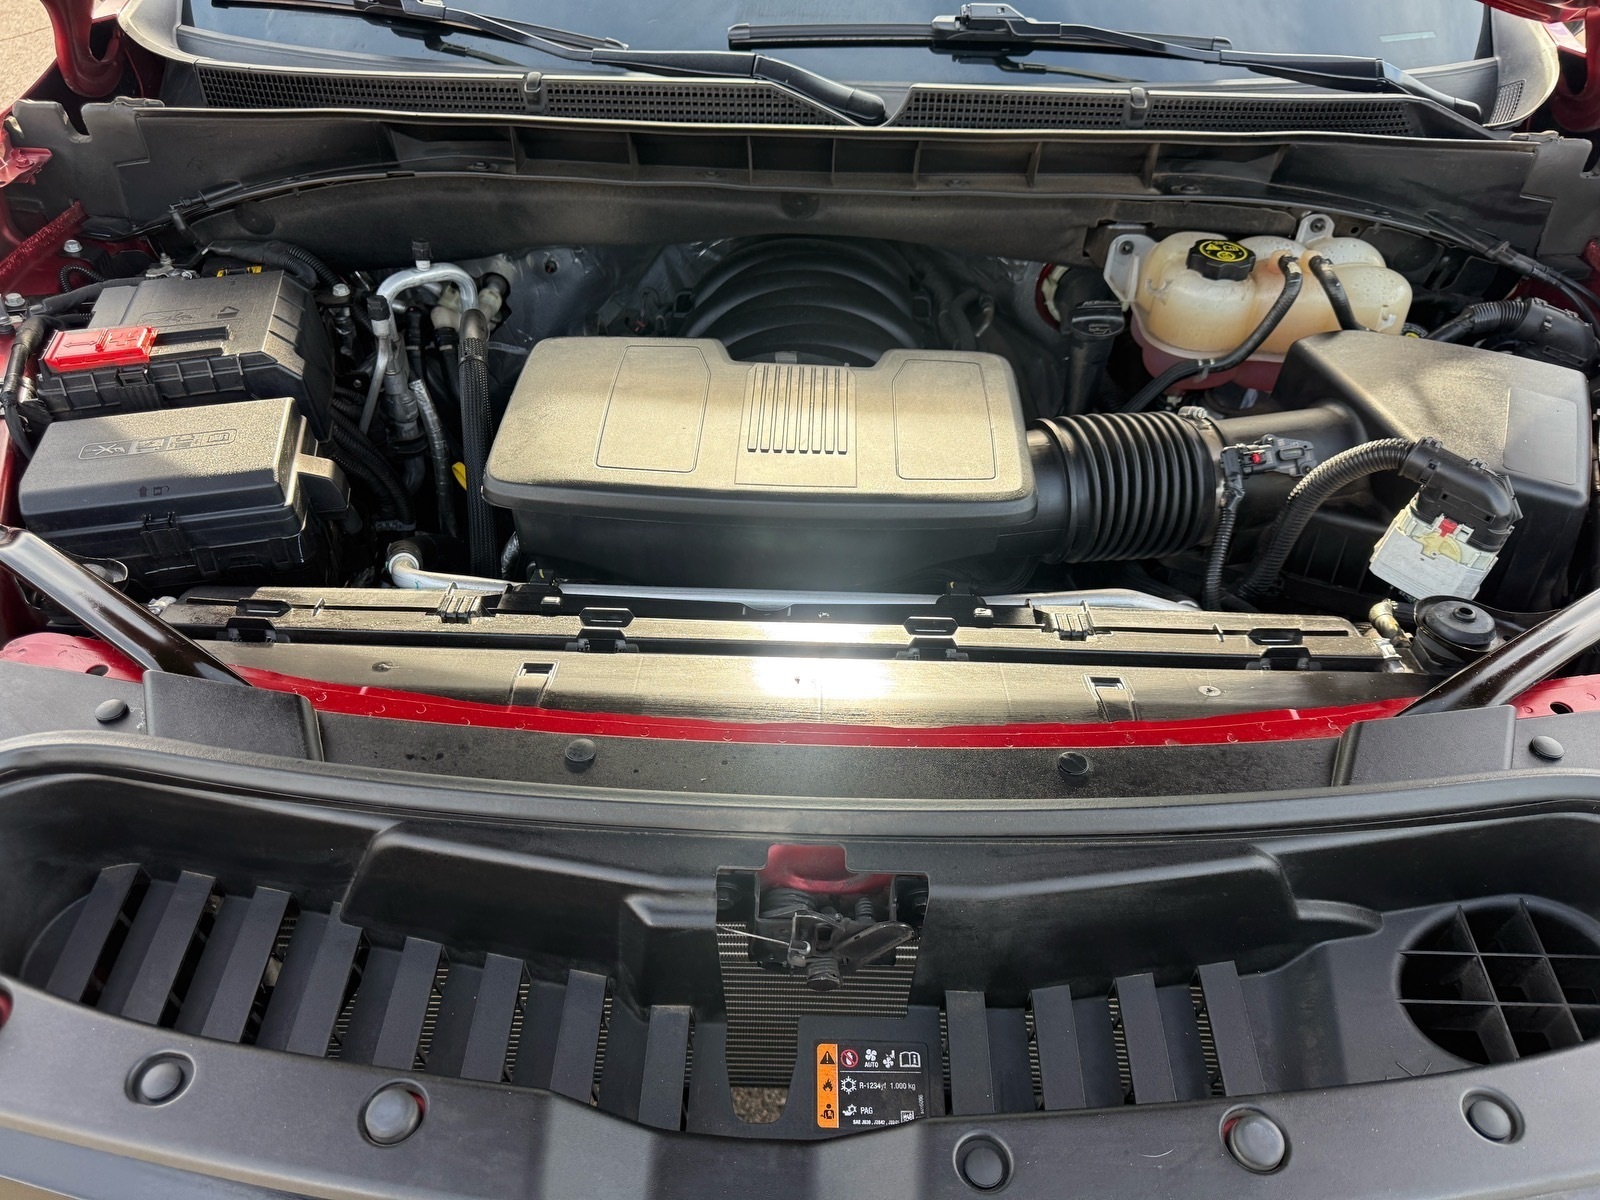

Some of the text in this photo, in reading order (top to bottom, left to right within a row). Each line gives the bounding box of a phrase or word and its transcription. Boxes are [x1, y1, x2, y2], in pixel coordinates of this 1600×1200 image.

[890, 1082, 907, 1090] 1.000
[907, 1082, 916, 1091] kg
[860, 1106, 873, 1115] PAG
